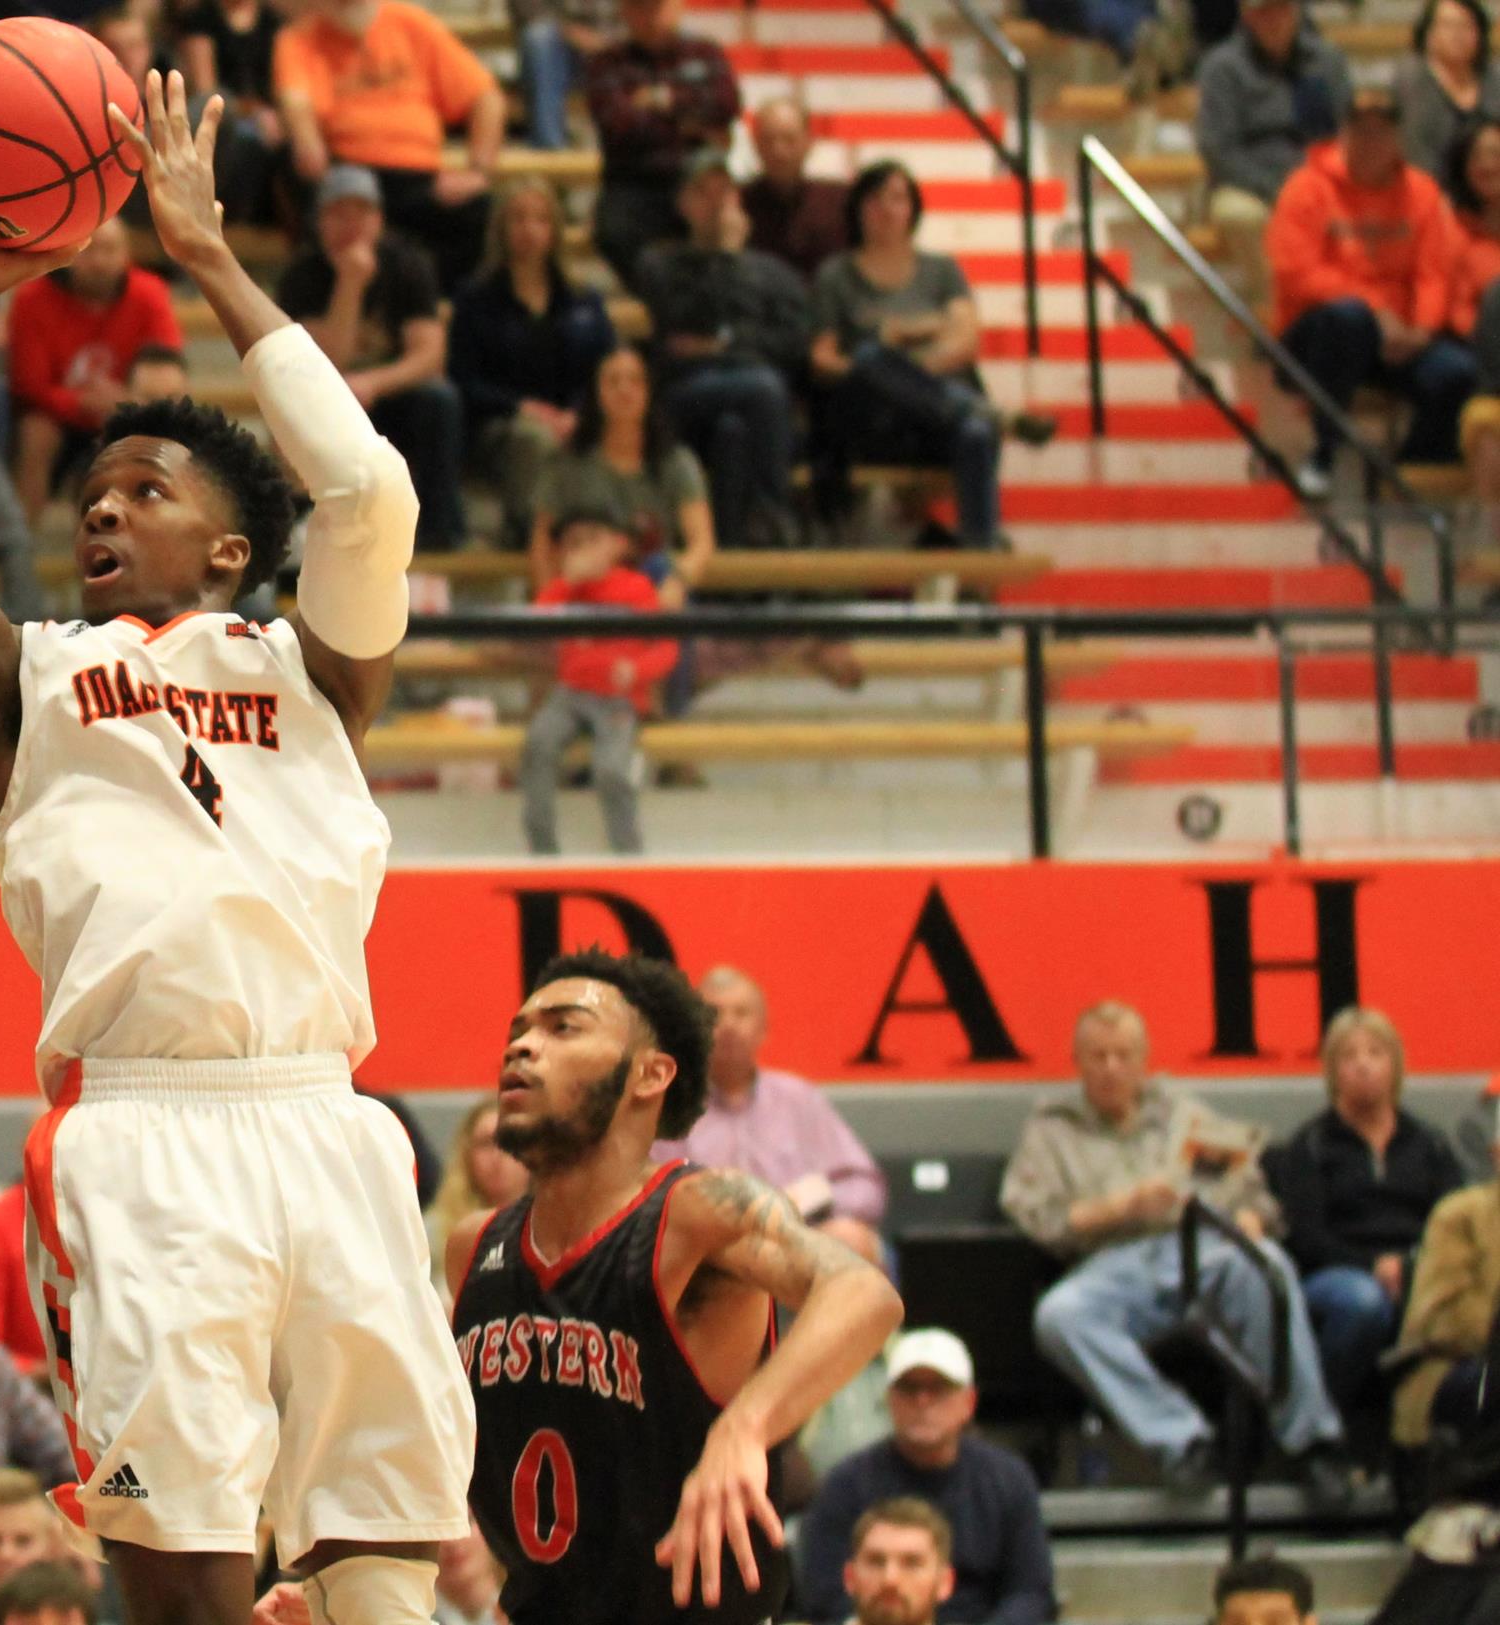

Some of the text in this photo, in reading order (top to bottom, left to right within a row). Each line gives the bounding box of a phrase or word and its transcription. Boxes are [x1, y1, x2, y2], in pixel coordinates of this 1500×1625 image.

[180, 741, 223, 830] 4
[99, 1484, 149, 1499] adidas
[512, 1428, 578, 1564] 0
